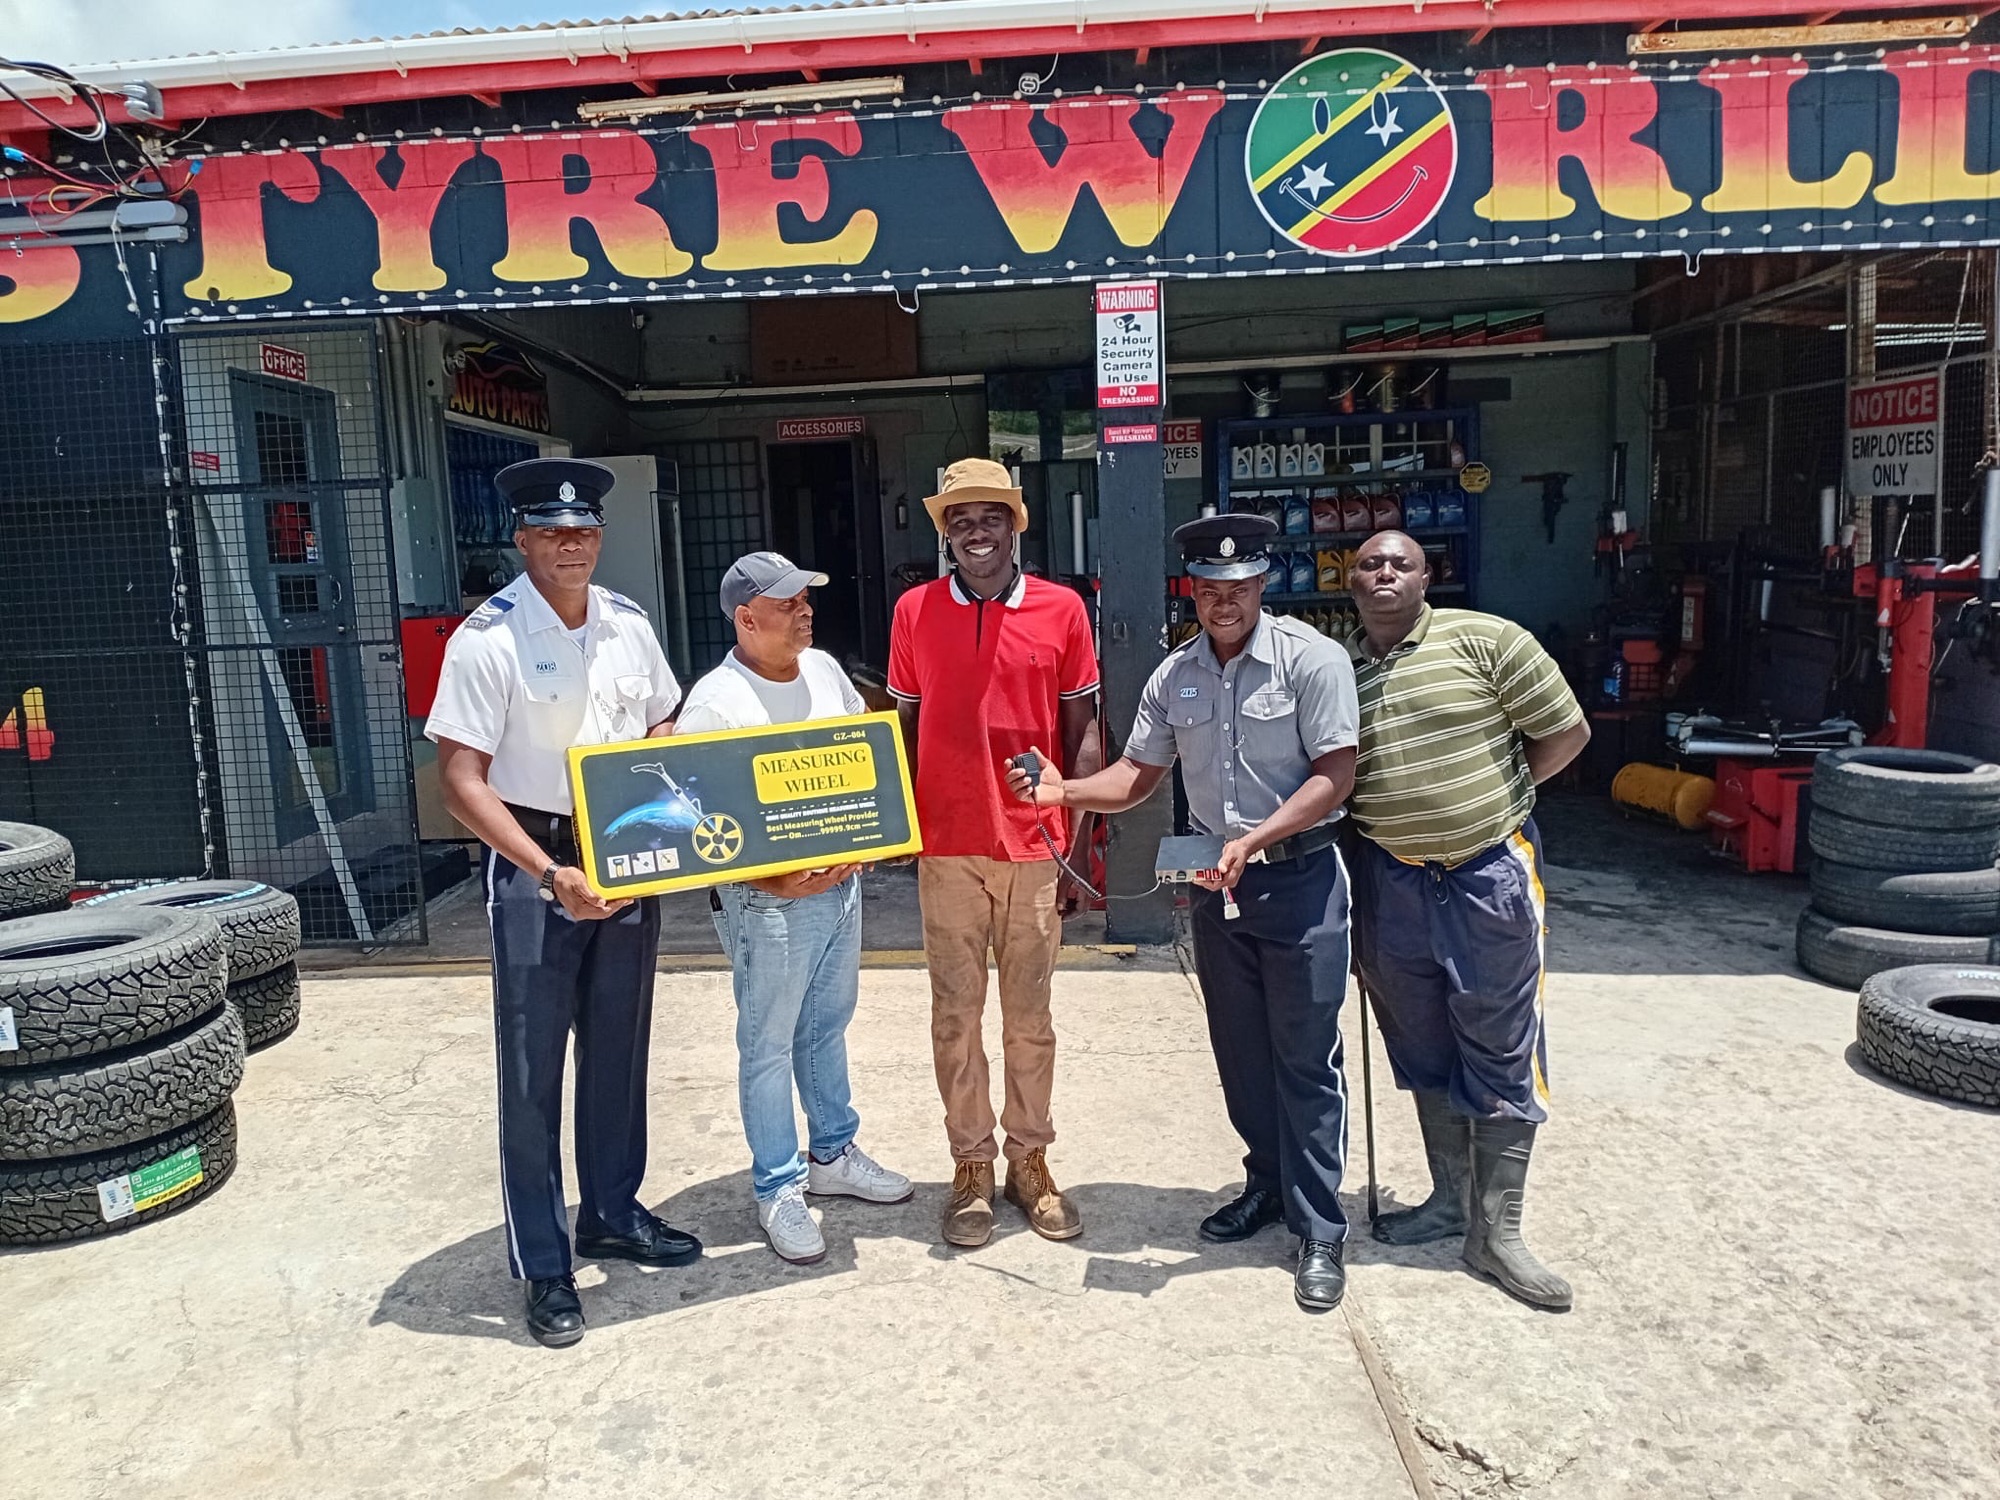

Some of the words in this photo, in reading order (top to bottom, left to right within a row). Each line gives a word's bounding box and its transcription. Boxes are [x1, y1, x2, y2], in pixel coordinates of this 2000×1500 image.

[146, 111, 878, 301] TYRE
[1099, 289, 1155, 310] WARNING
[1102, 337, 1117, 347] 24
[1122, 336, 1152, 346] Hour
[265, 350, 304, 377] OFFICE
[1101, 348, 1154, 359] Security
[1103, 361, 1152, 371] Camera
[1108, 375, 1120, 383] In
[1124, 374, 1148, 383] Use
[450, 371, 497, 419] AUTO
[501, 384, 550, 432] PARTS
[1102, 396, 1155, 405] TRESPASSING
[1119, 386, 1137, 397] NO
[1854, 383, 1935, 423] NOTICE
[781, 421, 862, 437] ACCESSORIES
[1852, 429, 1935, 460] EMPLOYEES
[1873, 463, 1908, 487] ONLY
[833, 730, 866, 741] GZ-004
[760, 749, 866, 776] MEASURING
[784, 774, 850, 793] WHEEL
[766, 824, 783, 833] Best
[784, 817, 824, 830] Measuring
[824, 814, 848, 825] Wheel
[848, 811, 879, 822] Provider
